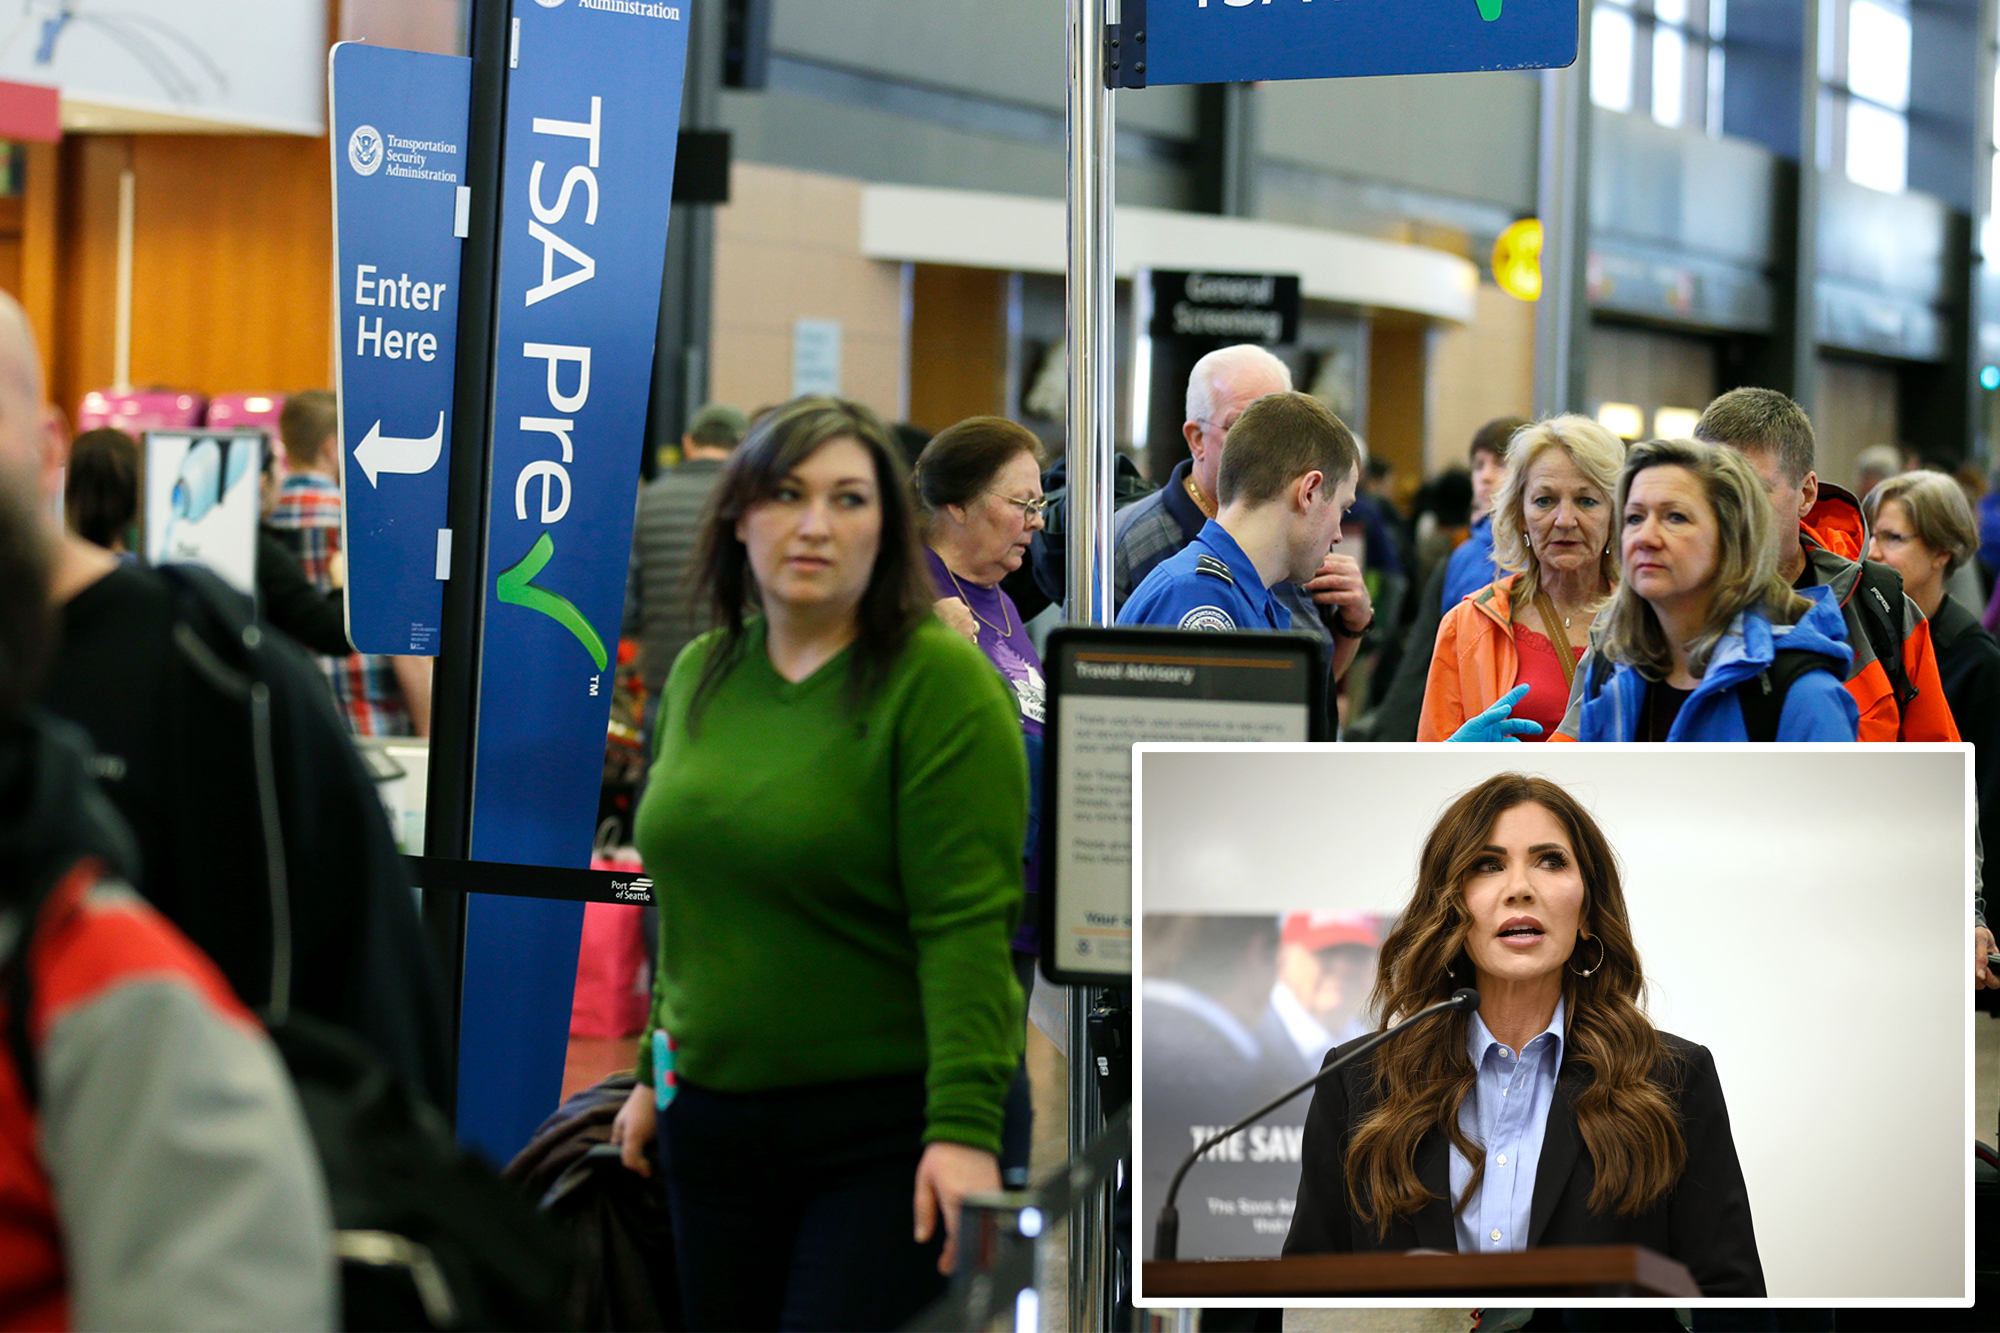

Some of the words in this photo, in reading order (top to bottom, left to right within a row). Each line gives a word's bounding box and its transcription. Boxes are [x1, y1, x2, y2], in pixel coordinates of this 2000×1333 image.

[578, 0, 680, 21] Administration
[387, 134, 457, 154] Transportation
[387, 149, 427, 168] Security
[385, 164, 457, 182] Administration
[525, 96, 602, 307] TSA
[356, 264, 447, 311] Enter
[1185, 273, 1276, 304] General
[1173, 301, 1283, 345] Screening
[357, 316, 438, 362] Here
[515, 342, 592, 524] Pre
[1075, 661, 1123, 681] Travel
[1125, 664, 1195, 686] Advisory
[611, 880, 628, 890] Port
[615, 890, 624, 899] of
[624, 891, 650, 901] Seattle
[1190, 1126, 1245, 1162] THE
[1249, 1126, 1303, 1162] SAV
